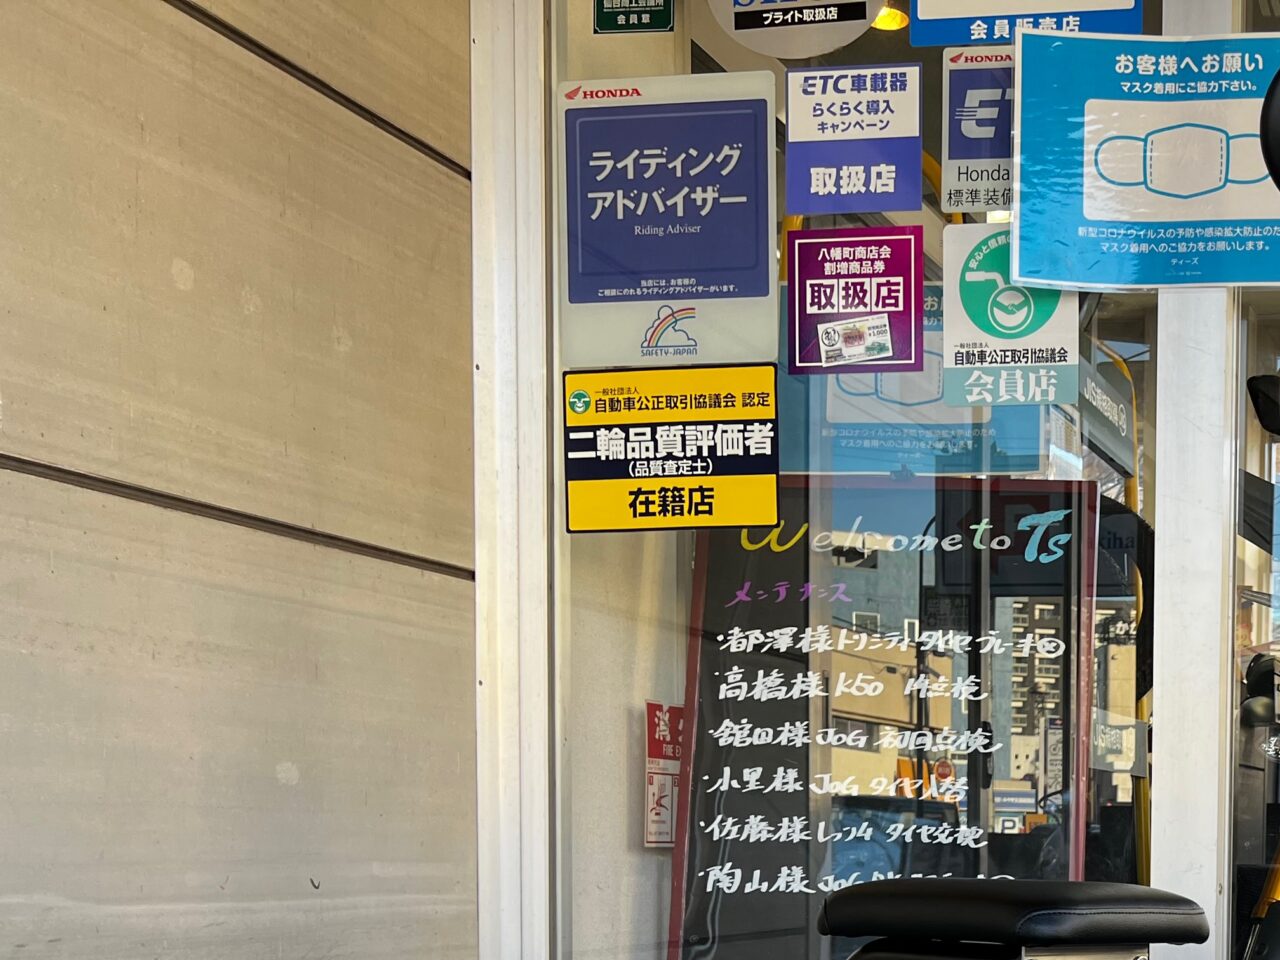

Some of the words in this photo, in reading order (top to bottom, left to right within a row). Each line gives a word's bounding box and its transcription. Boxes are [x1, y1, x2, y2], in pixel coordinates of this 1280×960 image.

[762, 7, 839, 25] ブライト取扱店
[964, 54, 1013, 64] HONDA
[1115, 52, 1264, 77] お客様へお願い
[583, 87, 642, 100] HONDA
[801, 72, 908, 97] ETC車載器
[1120, 80, 1258, 94] マスク着用にご協力下さい。
[811, 100, 896, 118] らくらく導入
[817, 118, 891, 134] キャンペーン
[589, 142, 744, 182] ライディング
[809, 163, 897, 196] 取扱店
[957, 164, 1010, 182] Honda
[587, 184, 748, 221] アドバイザー
[634, 224, 665, 237] Riding
[666, 223, 702, 235] Adviser
[818, 245, 892, 261] 八幡町商店会
[1099, 240, 1270, 254] マスク着用へのご協力をお願いします。
[824, 261, 886, 276] 割増商品券
[808, 279, 902, 312] 取扱店
[953, 347, 1069, 367] 自動車公正取引協議会
[594, 387, 640, 396] 一般社団法人
[963, 369, 1059, 404] 会員店
[594, 393, 737, 414] 自動車公正取引協議会
[741, 391, 771, 408] 認定
[567, 422, 775, 461] 二輪品質評価者
[628, 485, 715, 519] 在籍店
[968, 517, 1012, 551] to
[725, 580, 853, 608] メンテナンス
